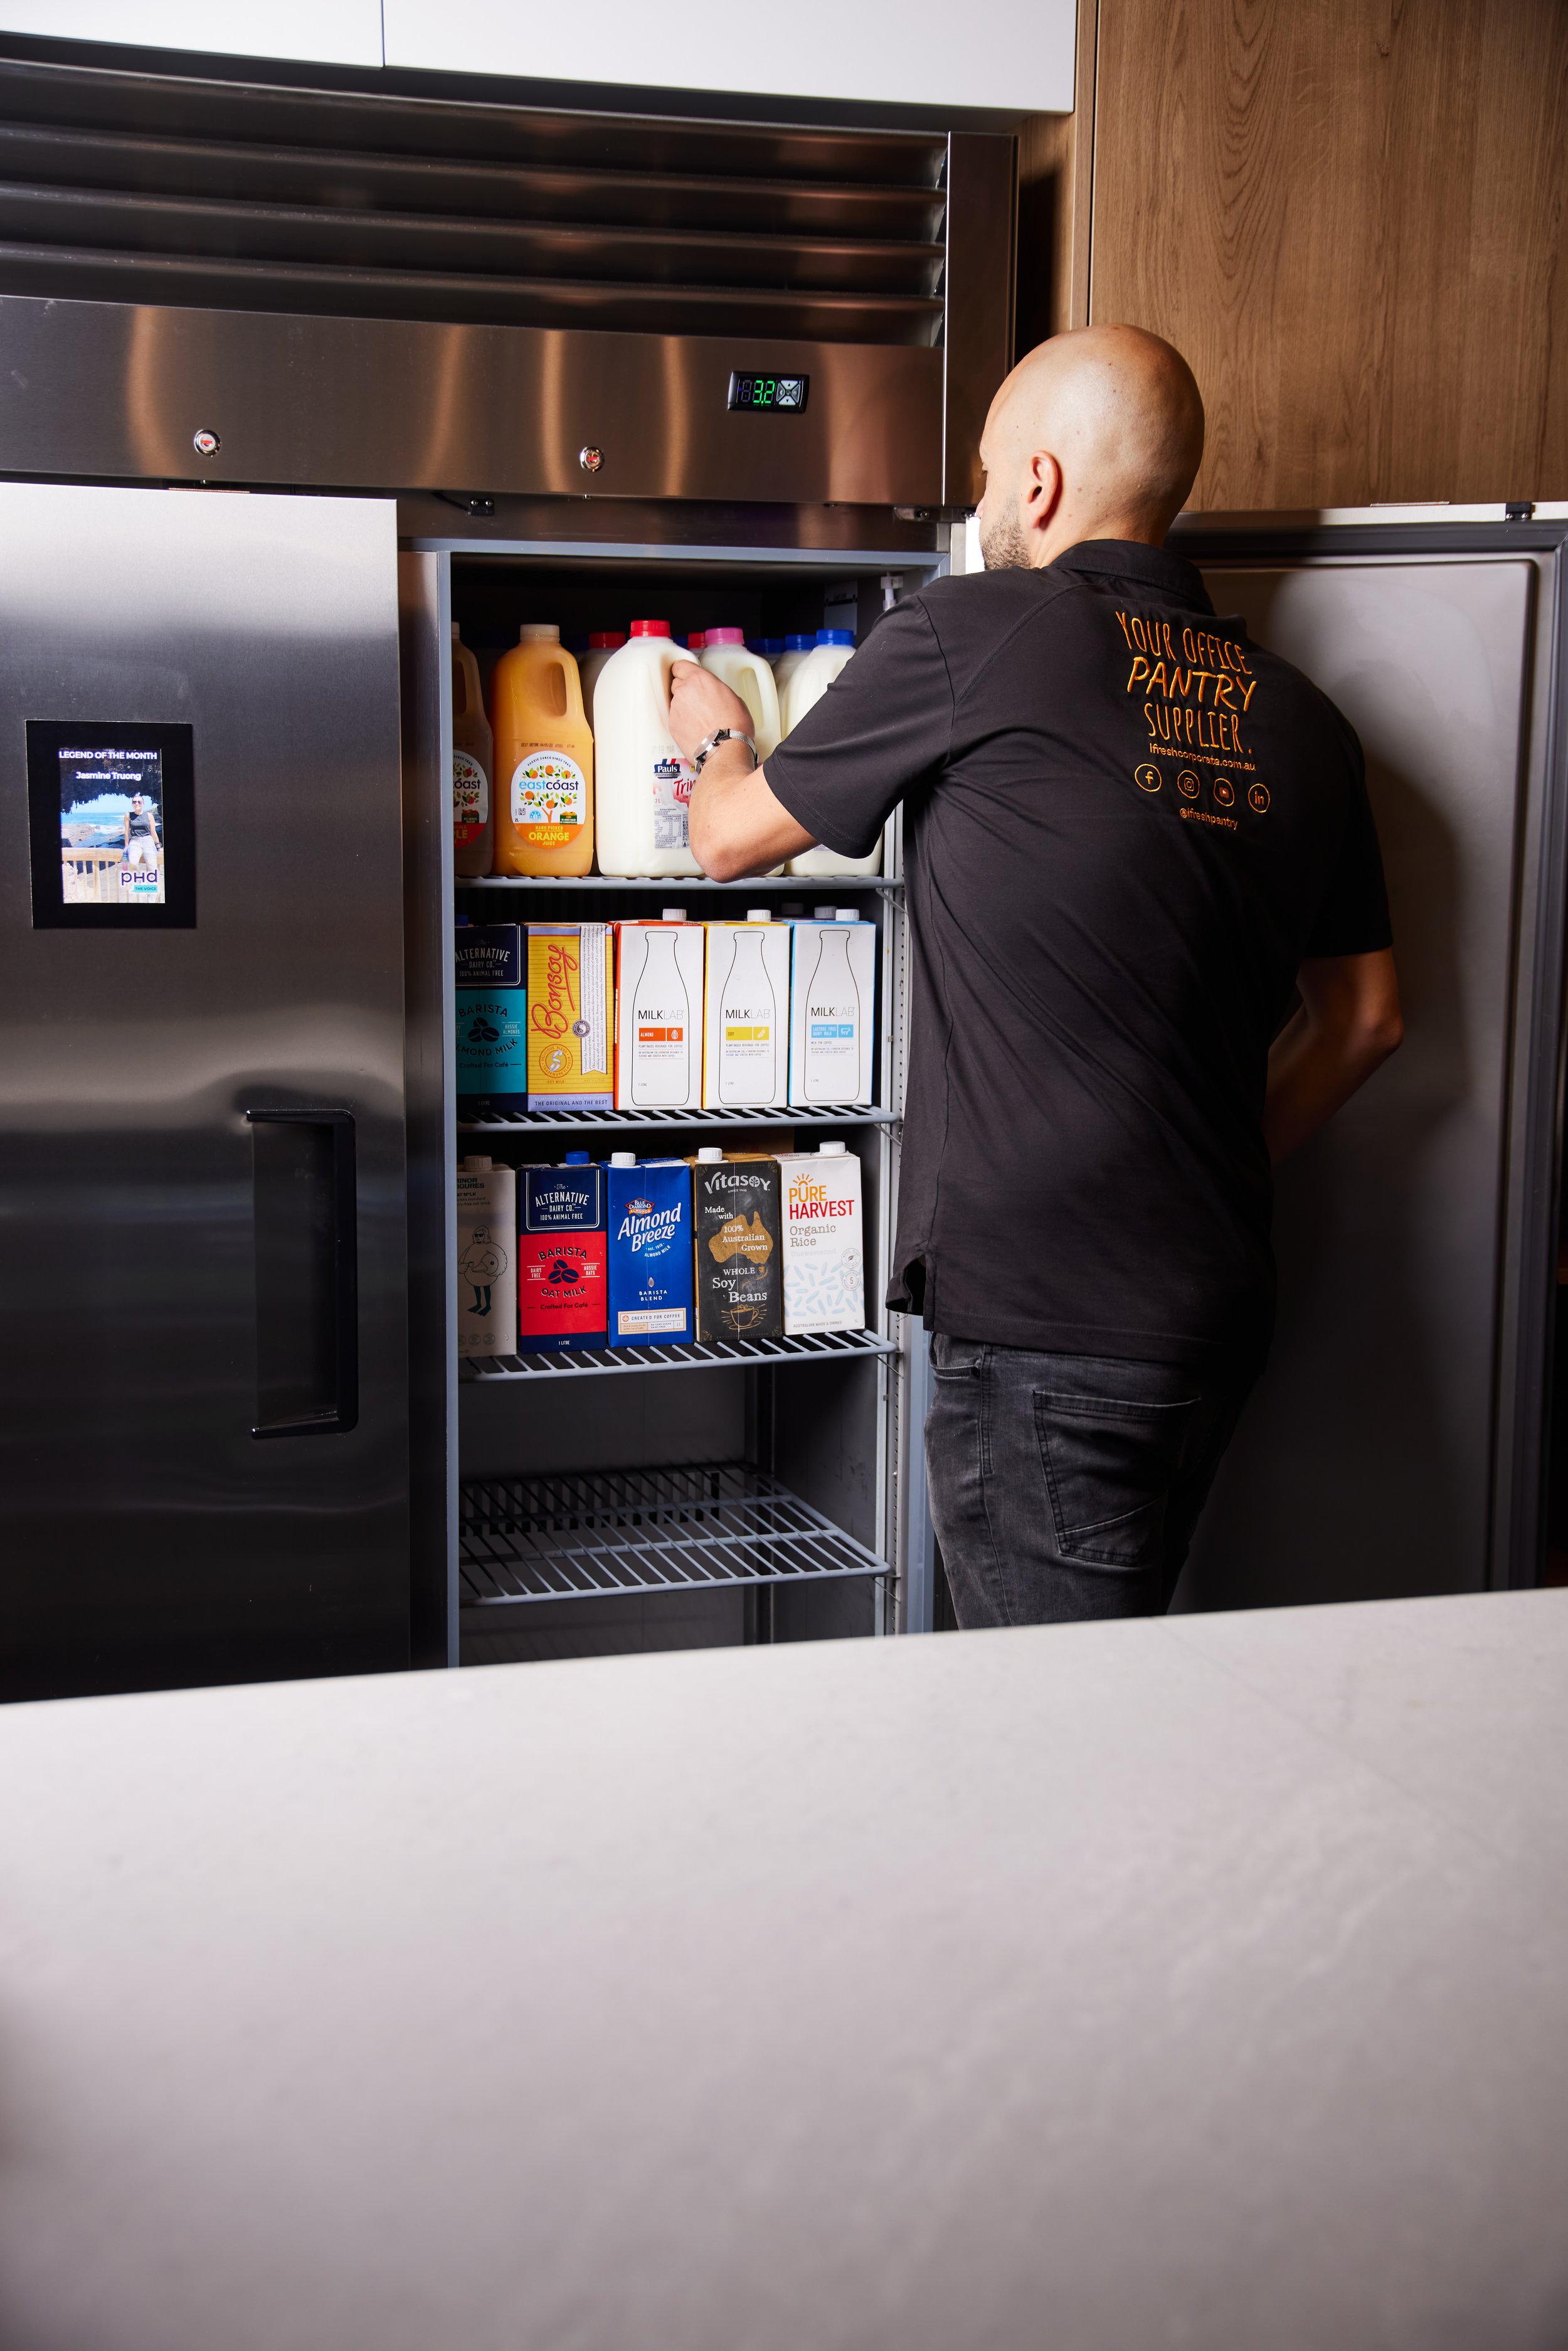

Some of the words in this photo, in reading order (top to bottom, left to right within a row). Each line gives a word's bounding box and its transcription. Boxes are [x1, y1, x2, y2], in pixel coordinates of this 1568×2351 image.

[753, 380, 775, 404] 3.2
[1116, 611, 1177, 661] YOUR
[1184, 628, 1253, 674] OFFICE
[1127, 656, 1257, 711] PANTRY
[1144, 703, 1252, 754] SUPPLIER.
[112, 772, 142, 781] Truong
[528, 832, 569, 841] ORANGE
[455, 948, 511, 963] ALTERNATIVE
[531, 943, 578, 1039] Bonsoy
[458, 1004, 507, 1018] BARISTA
[456, 1043, 492, 1056] LMOND
[495, 1038, 518, 1054] MILK
[541, 1046, 555, 1062] DELICIOUS
[556, 1046, 568, 1054] BLEND
[542, 1065, 564, 1076] TRADEMARK
[536, 1192, 590, 1207] ALTERNATIVE
[789, 1185, 827, 1204] PURE
[790, 1199, 855, 1220] HARVEST
[617, 1202, 682, 1241] Almond
[724, 1224, 744, 1233] 100%
[790, 1224, 836, 1236] Organic
[632, 1224, 675, 1252] Breeze
[723, 1234, 765, 1243] Australian
[790, 1238, 817, 1248] Rice
[538, 1246, 587, 1261] BARISTA
[661, 1244, 671, 1253] MILK
[723, 1268, 756, 1276] WHOLE
[712, 1277, 736, 1291] Soy
[850, 1276, 854, 1285] 5
[541, 1288, 560, 1298] OAT
[563, 1286, 587, 1298] MILK
[728, 1292, 767, 1303] Beans
